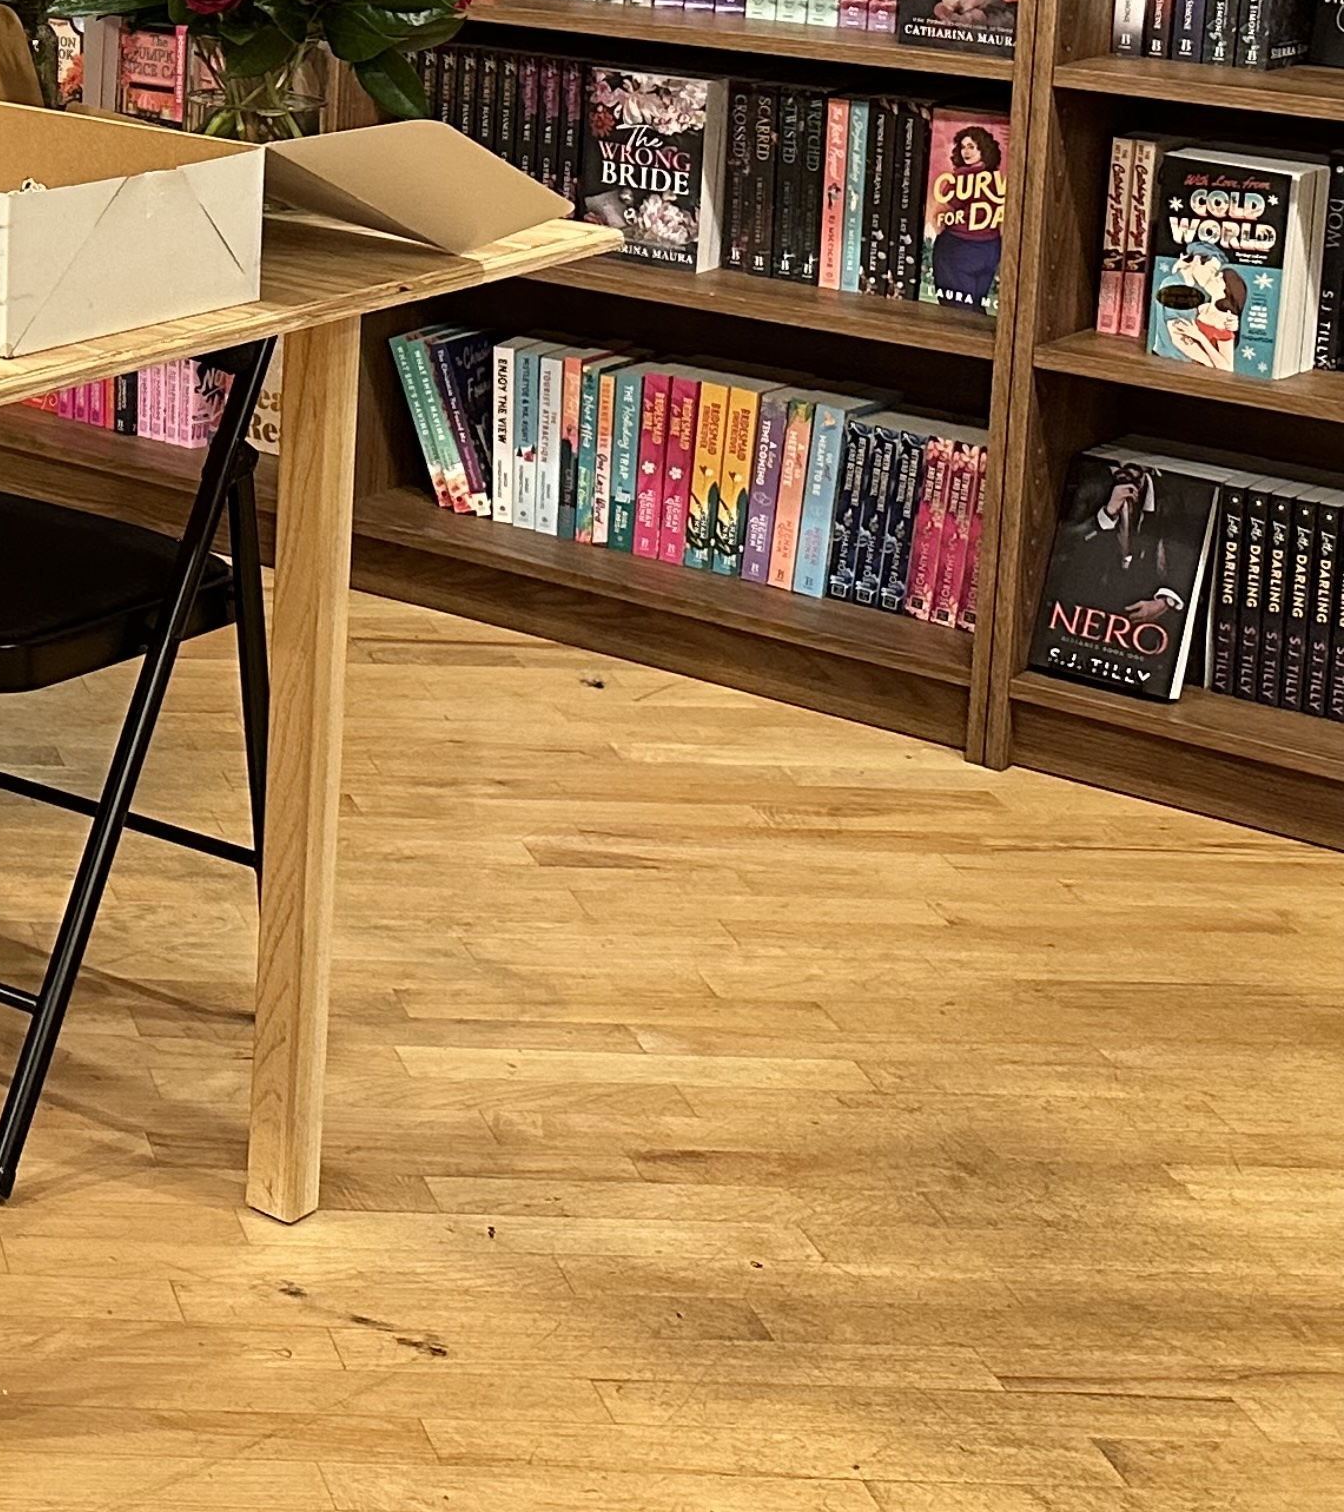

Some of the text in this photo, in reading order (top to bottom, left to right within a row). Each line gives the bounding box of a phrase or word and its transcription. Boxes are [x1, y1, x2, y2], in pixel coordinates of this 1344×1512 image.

[904, 23, 974, 43] CATHARINA
[616, 123, 663, 151] The
[732, 94, 747, 158] CROSSED
[755, 95, 772, 162] SCARRED
[598, 140, 691, 172] WRONG
[601, 160, 690, 196] BRIDE
[933, 170, 1008, 204] CURV
[1184, 173, 1209, 186] With
[1243, 177, 1270, 189] from
[937, 210, 965, 227] FOR
[1190, 189, 1266, 220] COLD
[1169, 216, 1277, 252] WORLD
[612, 244, 693, 265] ARINA MAURA
[927, 287, 973, 305] LAURA
[496, 359, 508, 444] ENJOY THE VIEW
[1268, 549, 1284, 614] DARLING
[1291, 554, 1308, 619] DARLING
[1316, 559, 1332, 624] DARLING
[1048, 600, 1169, 656] NERO
[1090, 658, 1151, 684] TILLY
